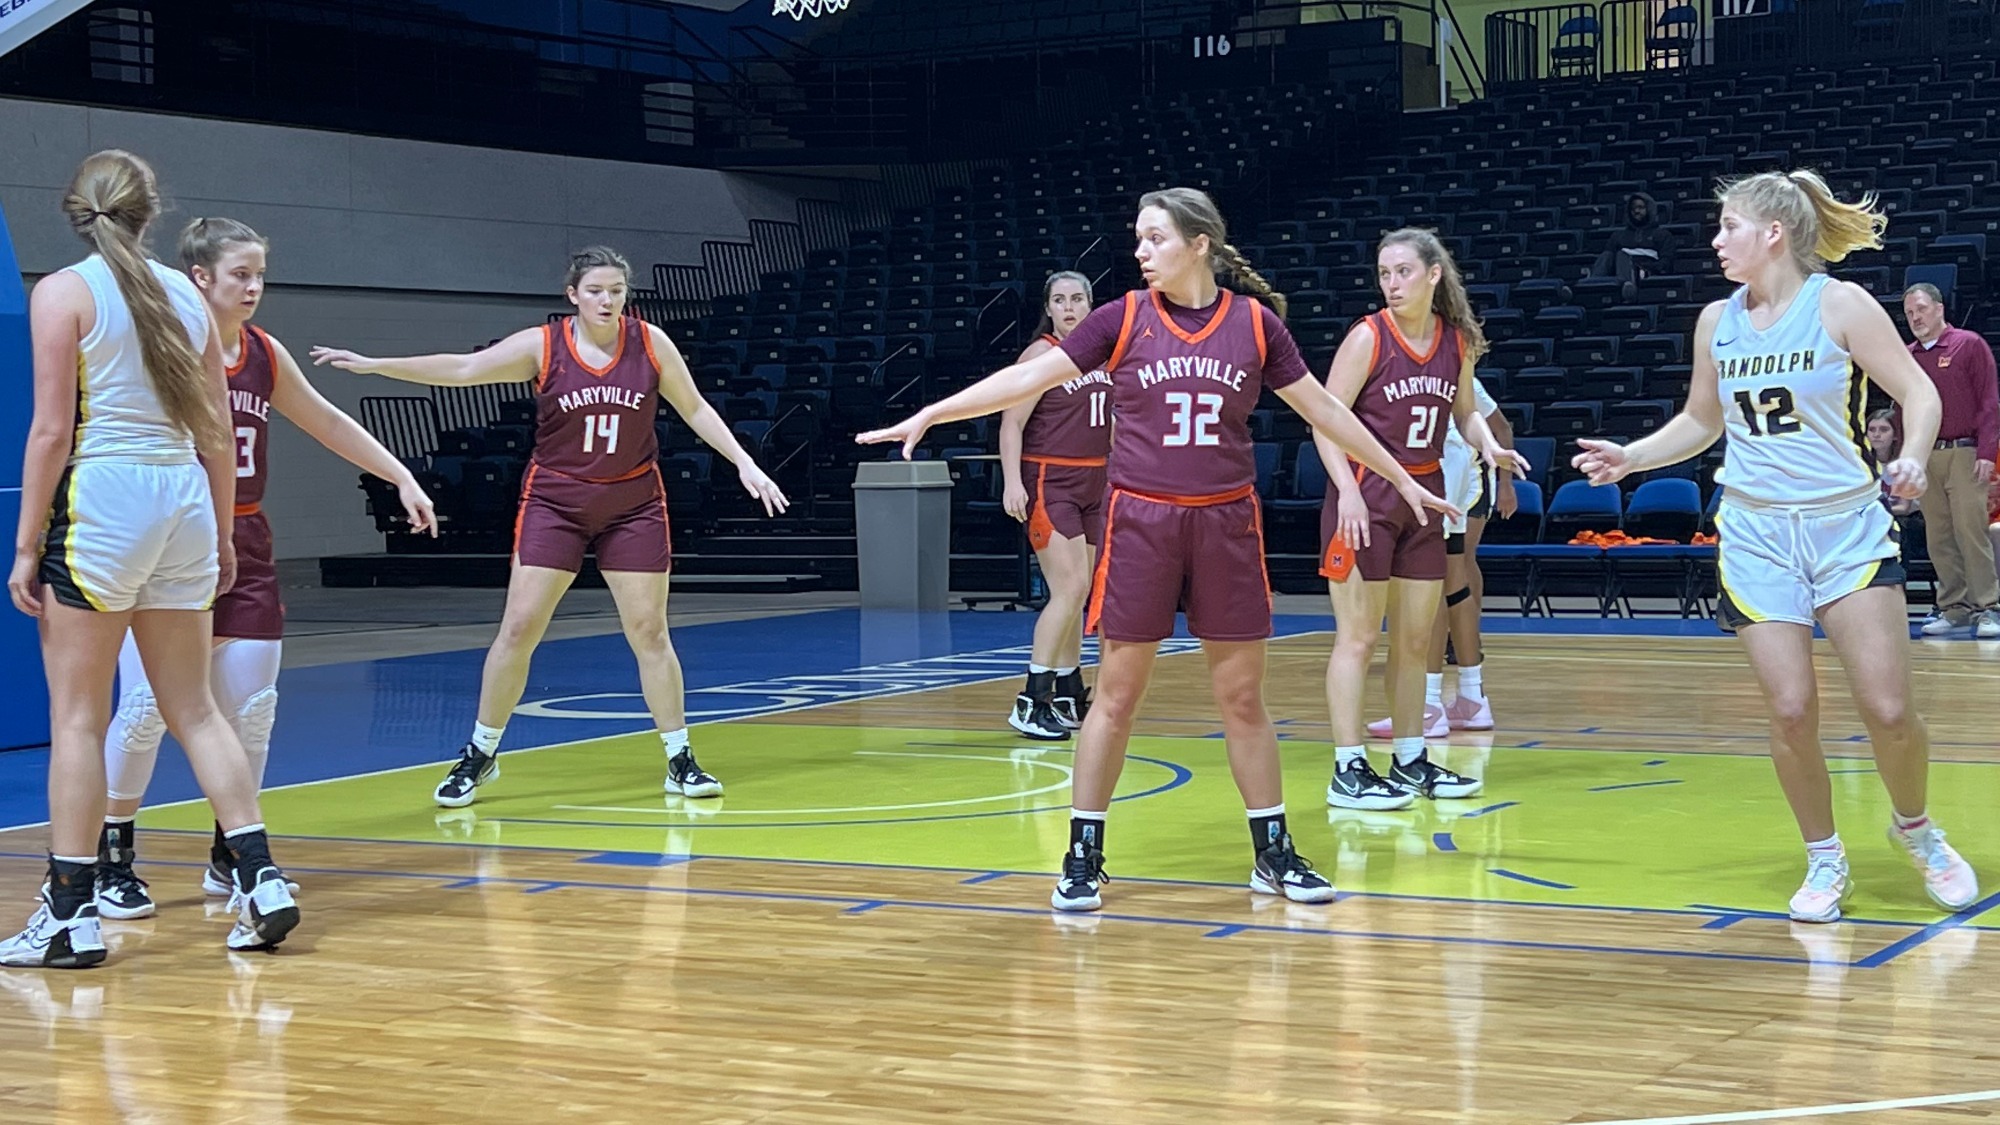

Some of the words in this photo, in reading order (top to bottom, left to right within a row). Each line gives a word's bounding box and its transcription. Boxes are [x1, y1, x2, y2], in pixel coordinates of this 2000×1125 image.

[1194, 34, 1231, 58] 116
[1137, 355, 1248, 392] MARYVILLE
[1383, 375, 1457, 403] MARYVILLE
[227, 389, 270, 422] VILLE
[558, 386, 645, 413] MARYVILLE
[1090, 391, 1106, 427] 11
[1733, 386, 1802, 437] 12
[583, 414, 620, 454] 14
[1162, 392, 1224, 446] 32
[1406, 406, 1439, 448] 21
